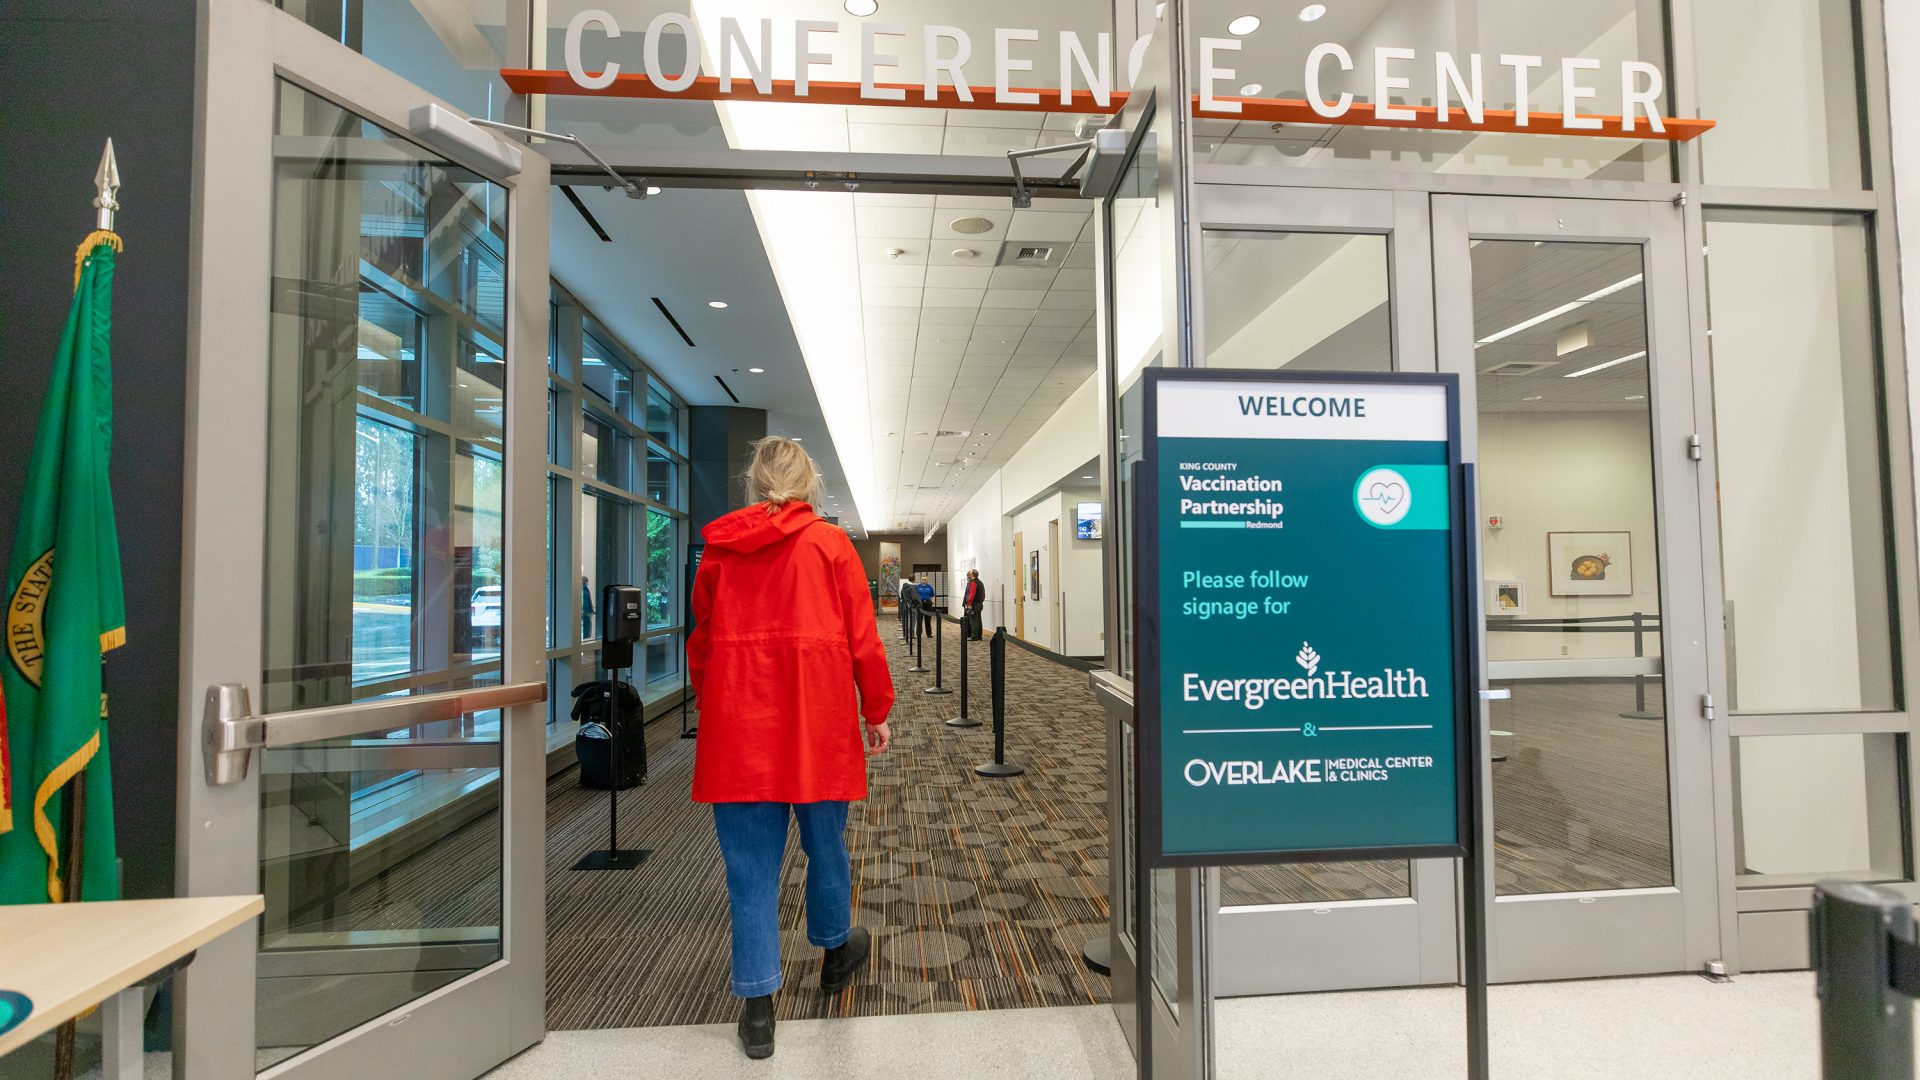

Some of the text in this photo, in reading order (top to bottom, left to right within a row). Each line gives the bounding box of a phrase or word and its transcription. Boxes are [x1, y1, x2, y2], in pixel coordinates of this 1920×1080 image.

[1303, 41, 1667, 134] CENTER
[1238, 395, 1366, 418] WELCOME
[1179, 462, 1238, 471] KING COUNTY
[1179, 475, 1283, 492] Vaccination
[1180, 499, 1284, 519] Partnership
[1246, 520, 1284, 529] Redmond
[1183, 570, 1309, 589] Please follow
[1183, 596, 1291, 620] signage for
[12, 622, 44, 668] THE
[1183, 667, 1429, 710] EvergreenHealth
[1303, 722, 1318, 737] &
[1184, 758, 1322, 787] OVERLAKE
[1329, 756, 1433, 770] MEDICAL CENTER
[1329, 769, 1389, 782] & CLINICS
